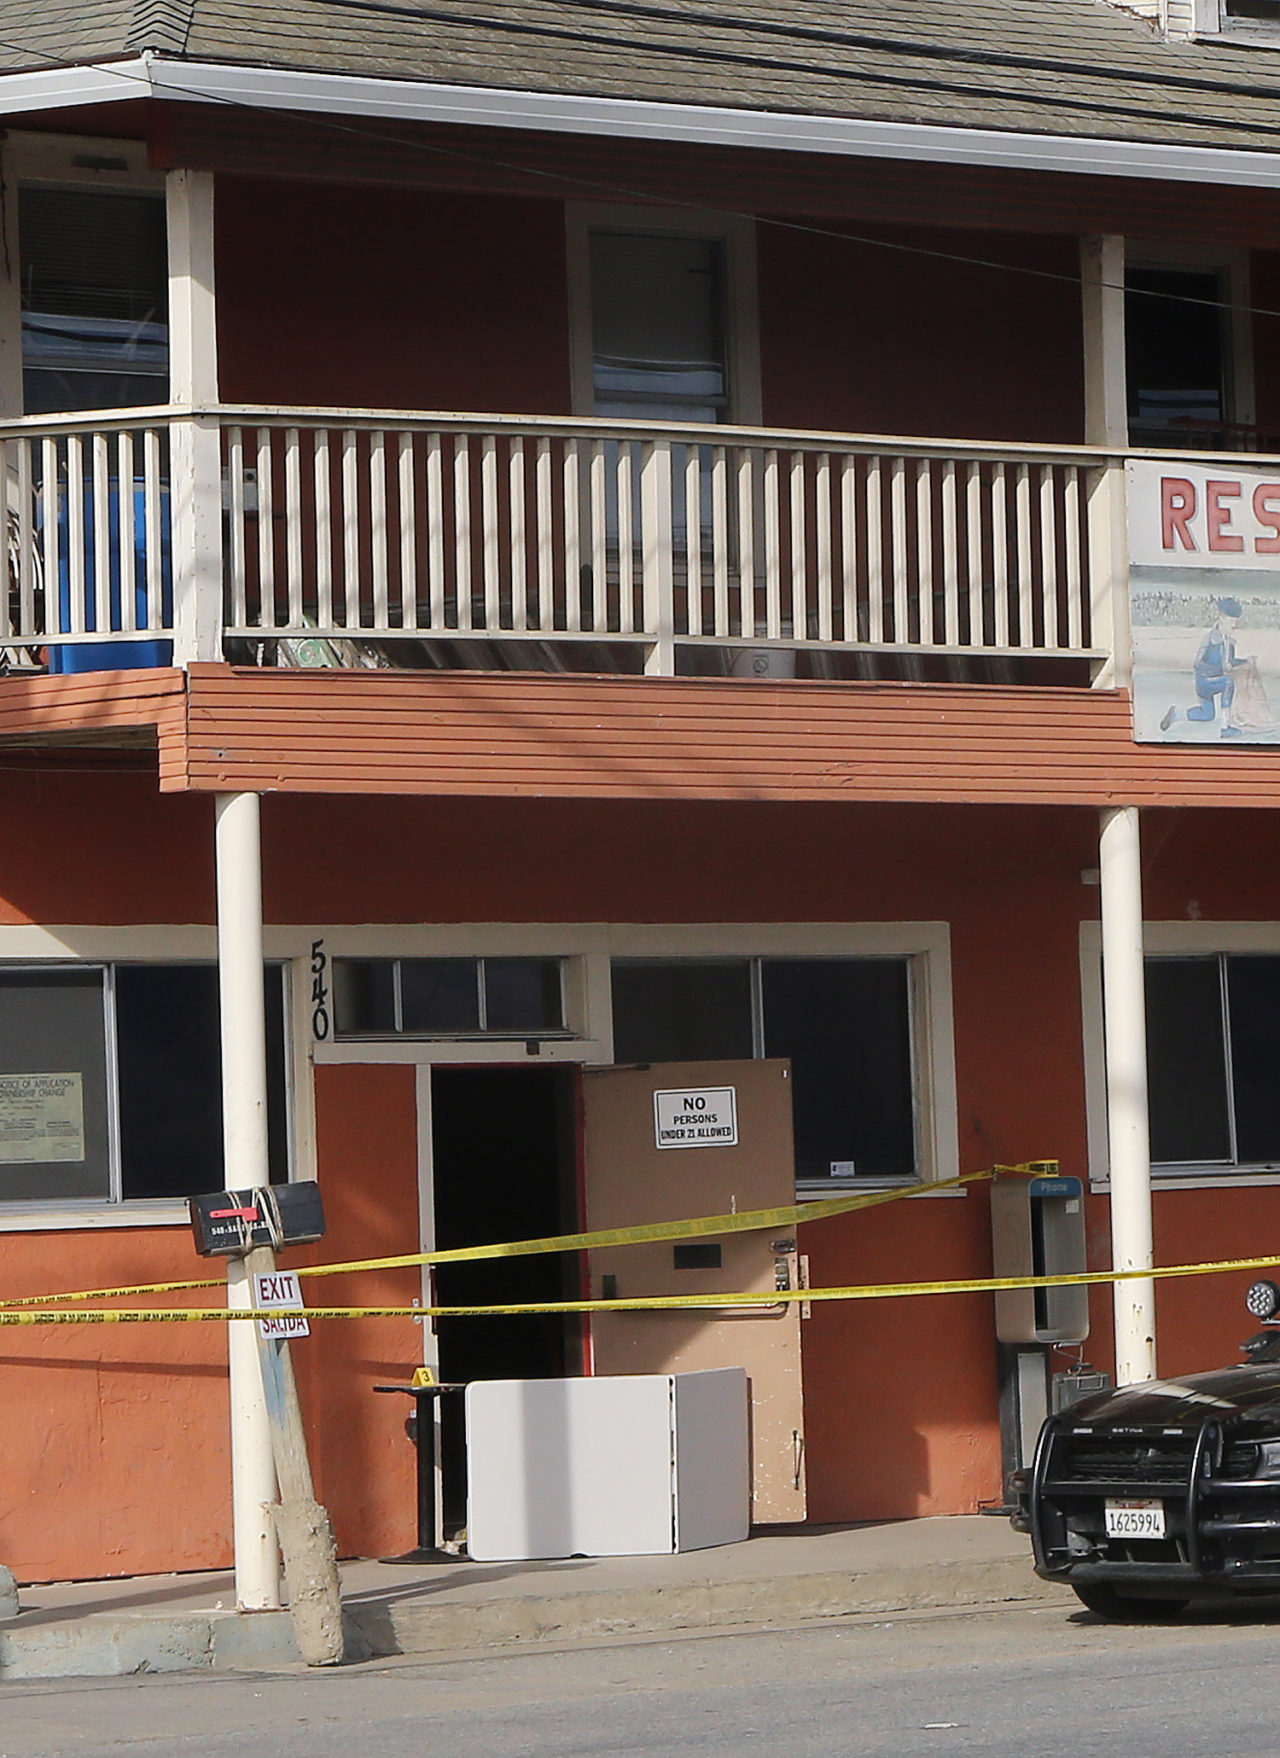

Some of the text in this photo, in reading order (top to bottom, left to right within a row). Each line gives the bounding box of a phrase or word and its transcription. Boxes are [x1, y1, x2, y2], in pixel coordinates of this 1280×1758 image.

[311, 938, 329, 1041] 540
[683, 1097, 706, 1111] NO
[673, 1113, 718, 1125] PERSONS
[661, 1126, 732, 1140] UNDER 21 ALLOWED
[1041, 1182, 1068, 1192] Phone
[260, 1277, 293, 1300] EXIT
[262, 1317, 306, 1334] SALIDA
[422, 1370, 430, 1382] 3
[1110, 1513, 1160, 1532] 1625994
